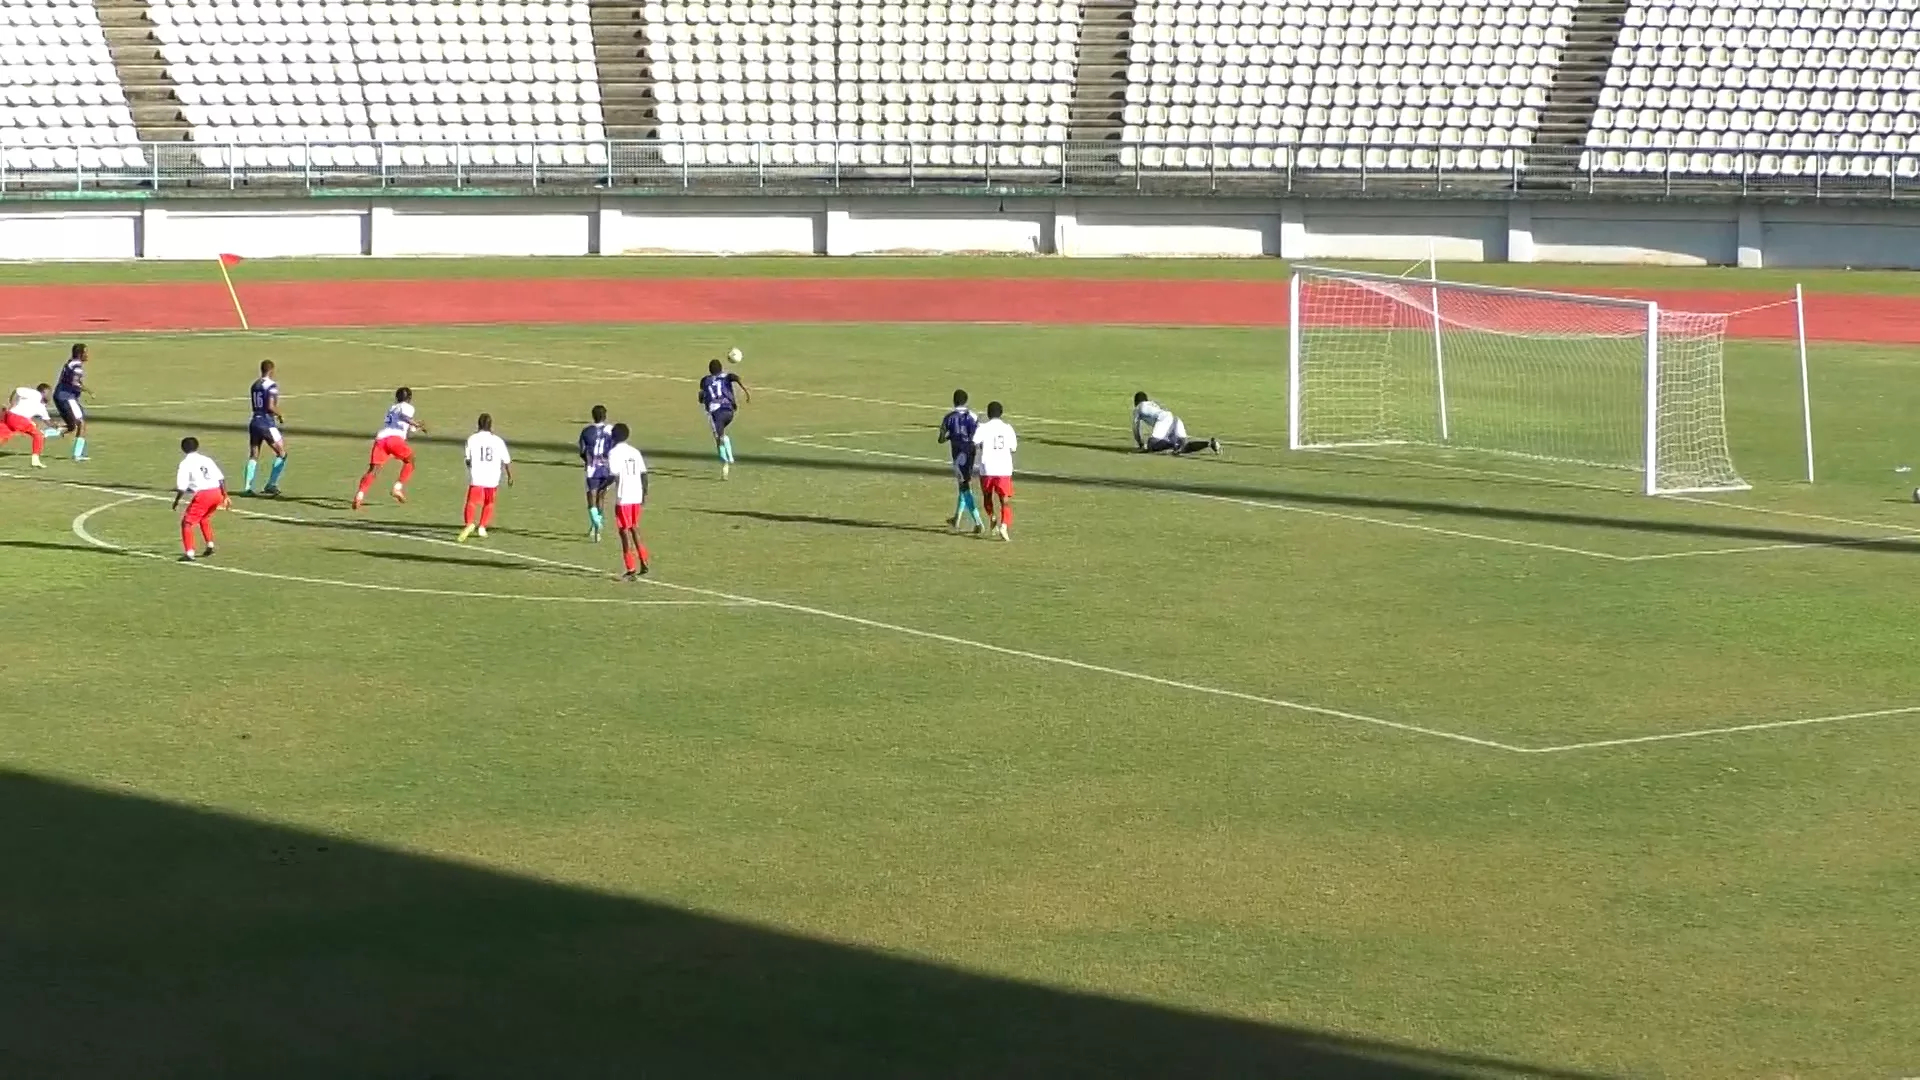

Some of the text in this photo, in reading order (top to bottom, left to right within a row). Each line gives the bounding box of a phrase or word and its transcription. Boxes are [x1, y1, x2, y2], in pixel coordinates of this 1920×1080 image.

[708, 380, 722, 398] 17
[253, 391, 265, 409] 16
[479, 446, 494, 462] 18
[624, 457, 637, 475] 17
